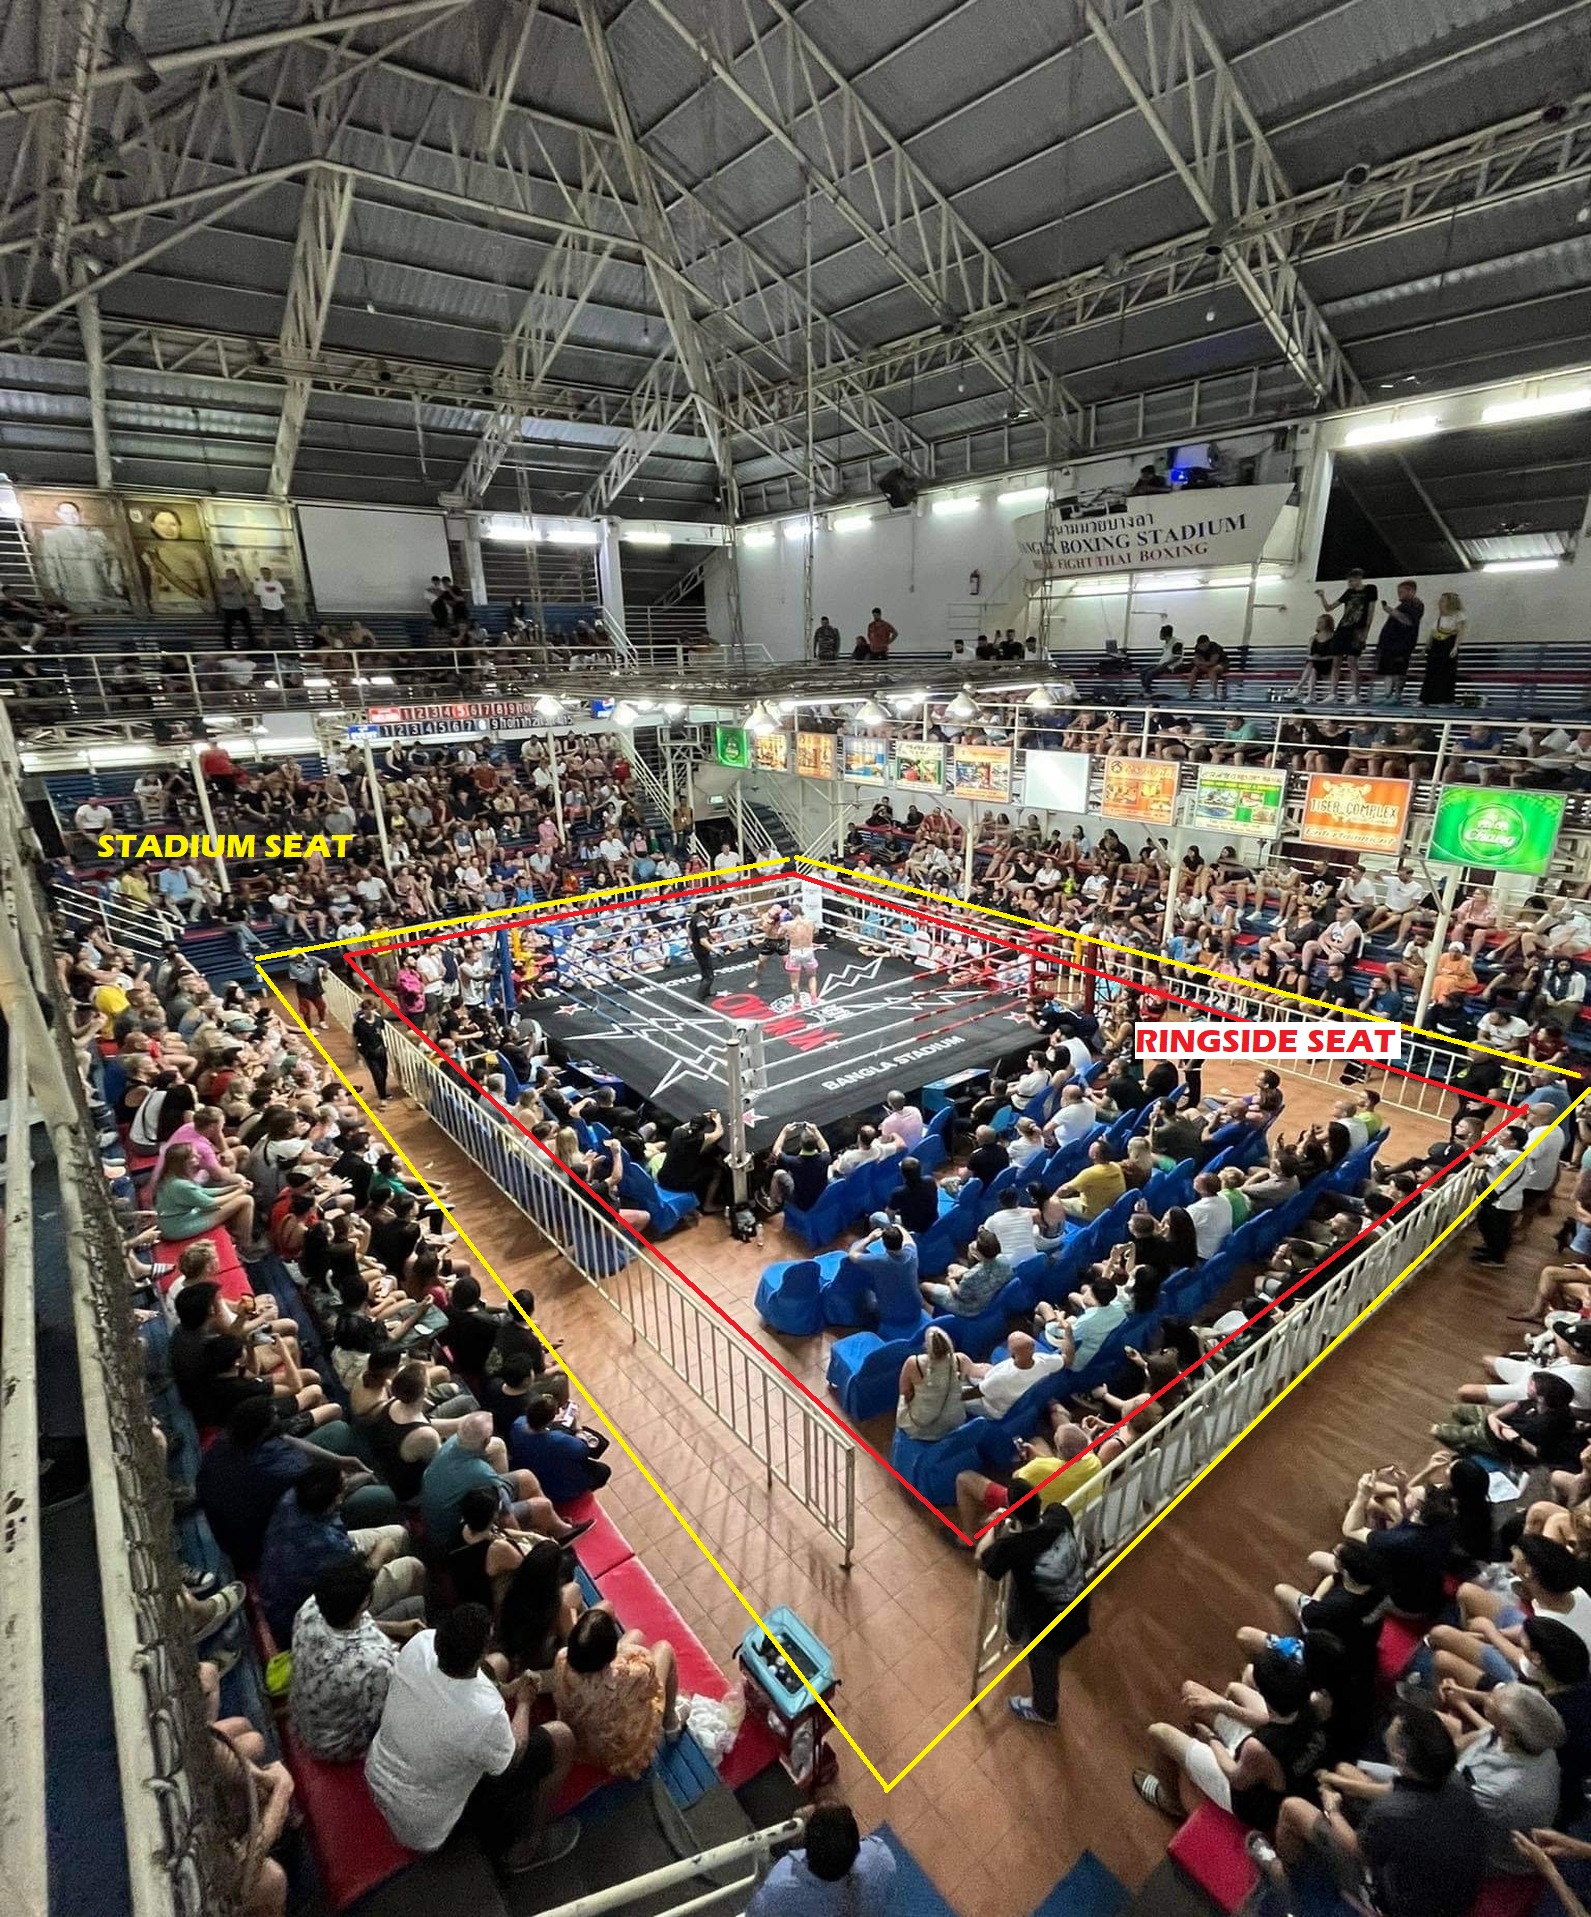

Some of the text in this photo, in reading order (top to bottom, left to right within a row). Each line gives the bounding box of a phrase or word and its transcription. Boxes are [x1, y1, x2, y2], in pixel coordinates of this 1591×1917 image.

[1061, 533, 1130, 555] BOXING
[1137, 513, 1247, 547] STADIUM
[1058, 557, 1092, 570] FIGHT
[1096, 552, 1132, 567] THAI
[1140, 541, 1209, 562] BOXING
[1346, 802, 1397, 819] COMPLEX
[821, 1034, 966, 1091] BANGLA STADIUM
